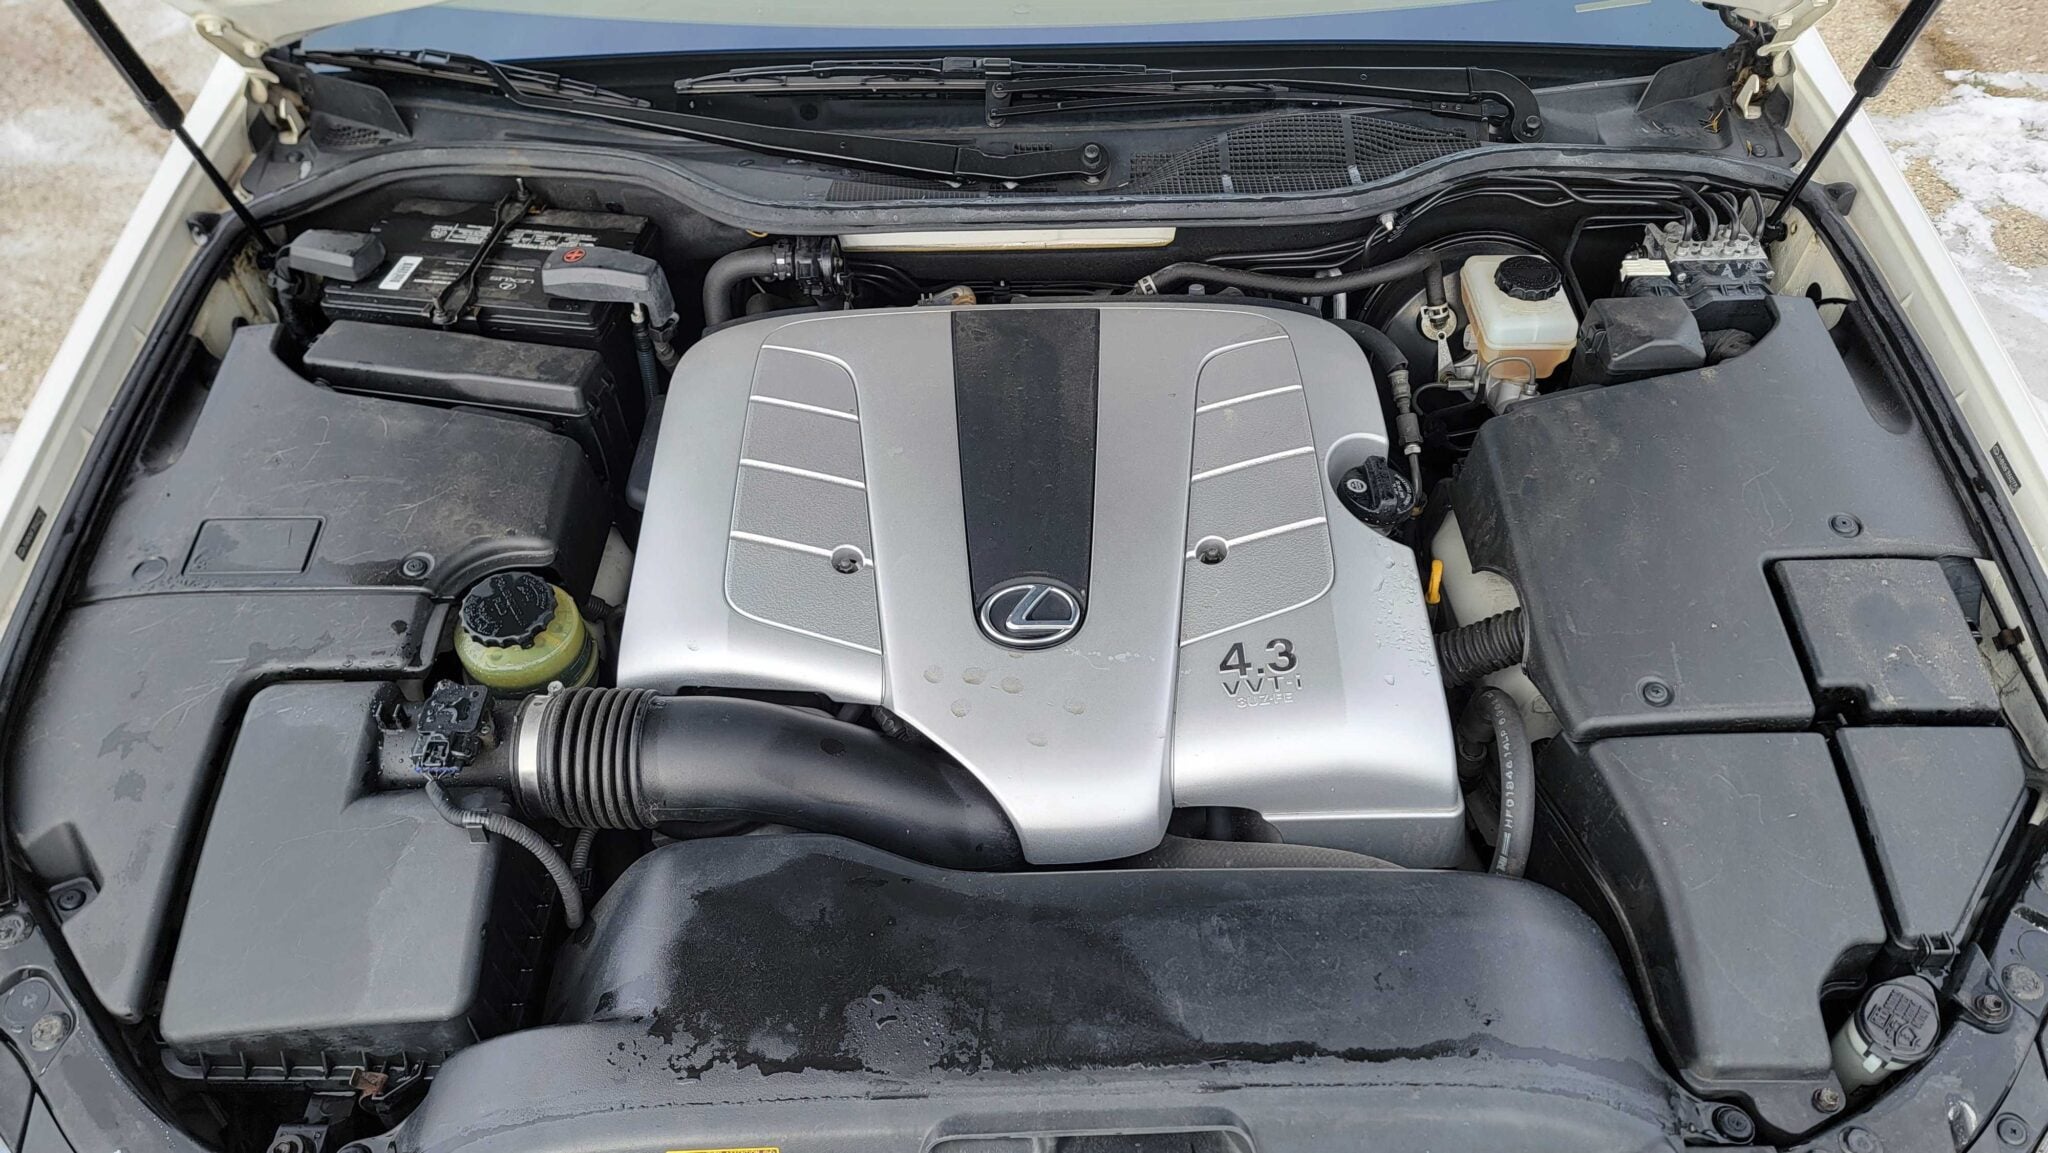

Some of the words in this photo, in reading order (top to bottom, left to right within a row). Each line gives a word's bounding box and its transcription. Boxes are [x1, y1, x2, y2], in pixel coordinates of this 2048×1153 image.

[489, 275, 535, 284] LEXUS
[1219, 638, 1298, 678] 4.3
[1221, 673, 1302, 698] VVT-i
[1237, 693, 1294, 708] 3UZ-FE
